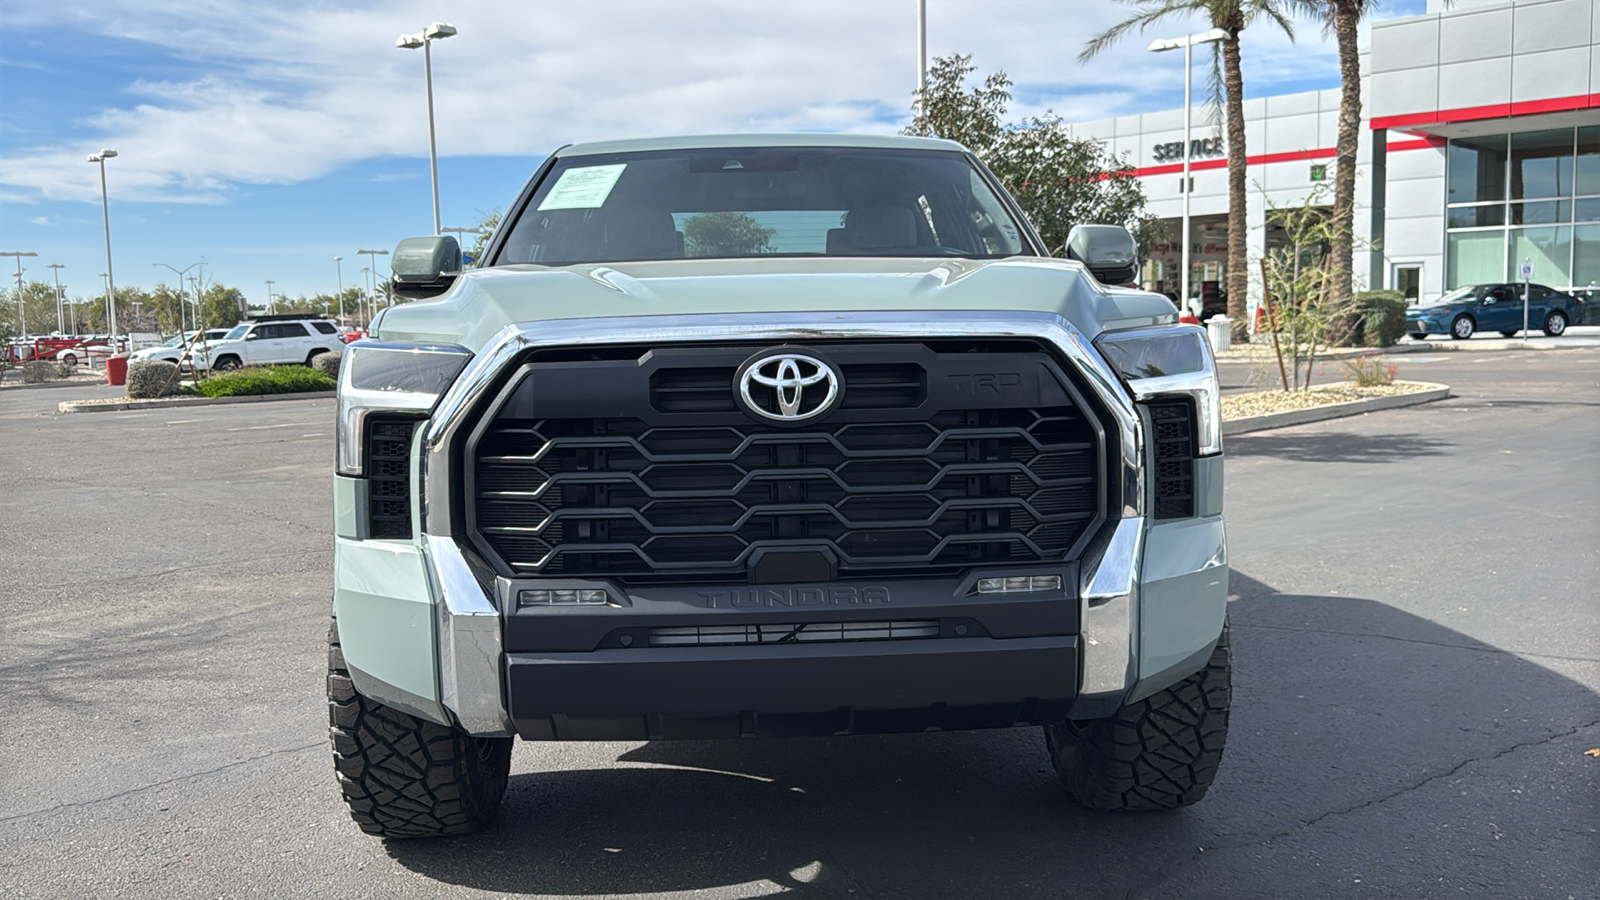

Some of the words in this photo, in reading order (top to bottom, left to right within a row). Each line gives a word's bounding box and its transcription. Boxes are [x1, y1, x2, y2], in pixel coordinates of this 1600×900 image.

[1152, 137, 1225, 161] SERVICE
[947, 373, 1021, 394] TRD
[696, 585, 891, 608] TUNDRA
